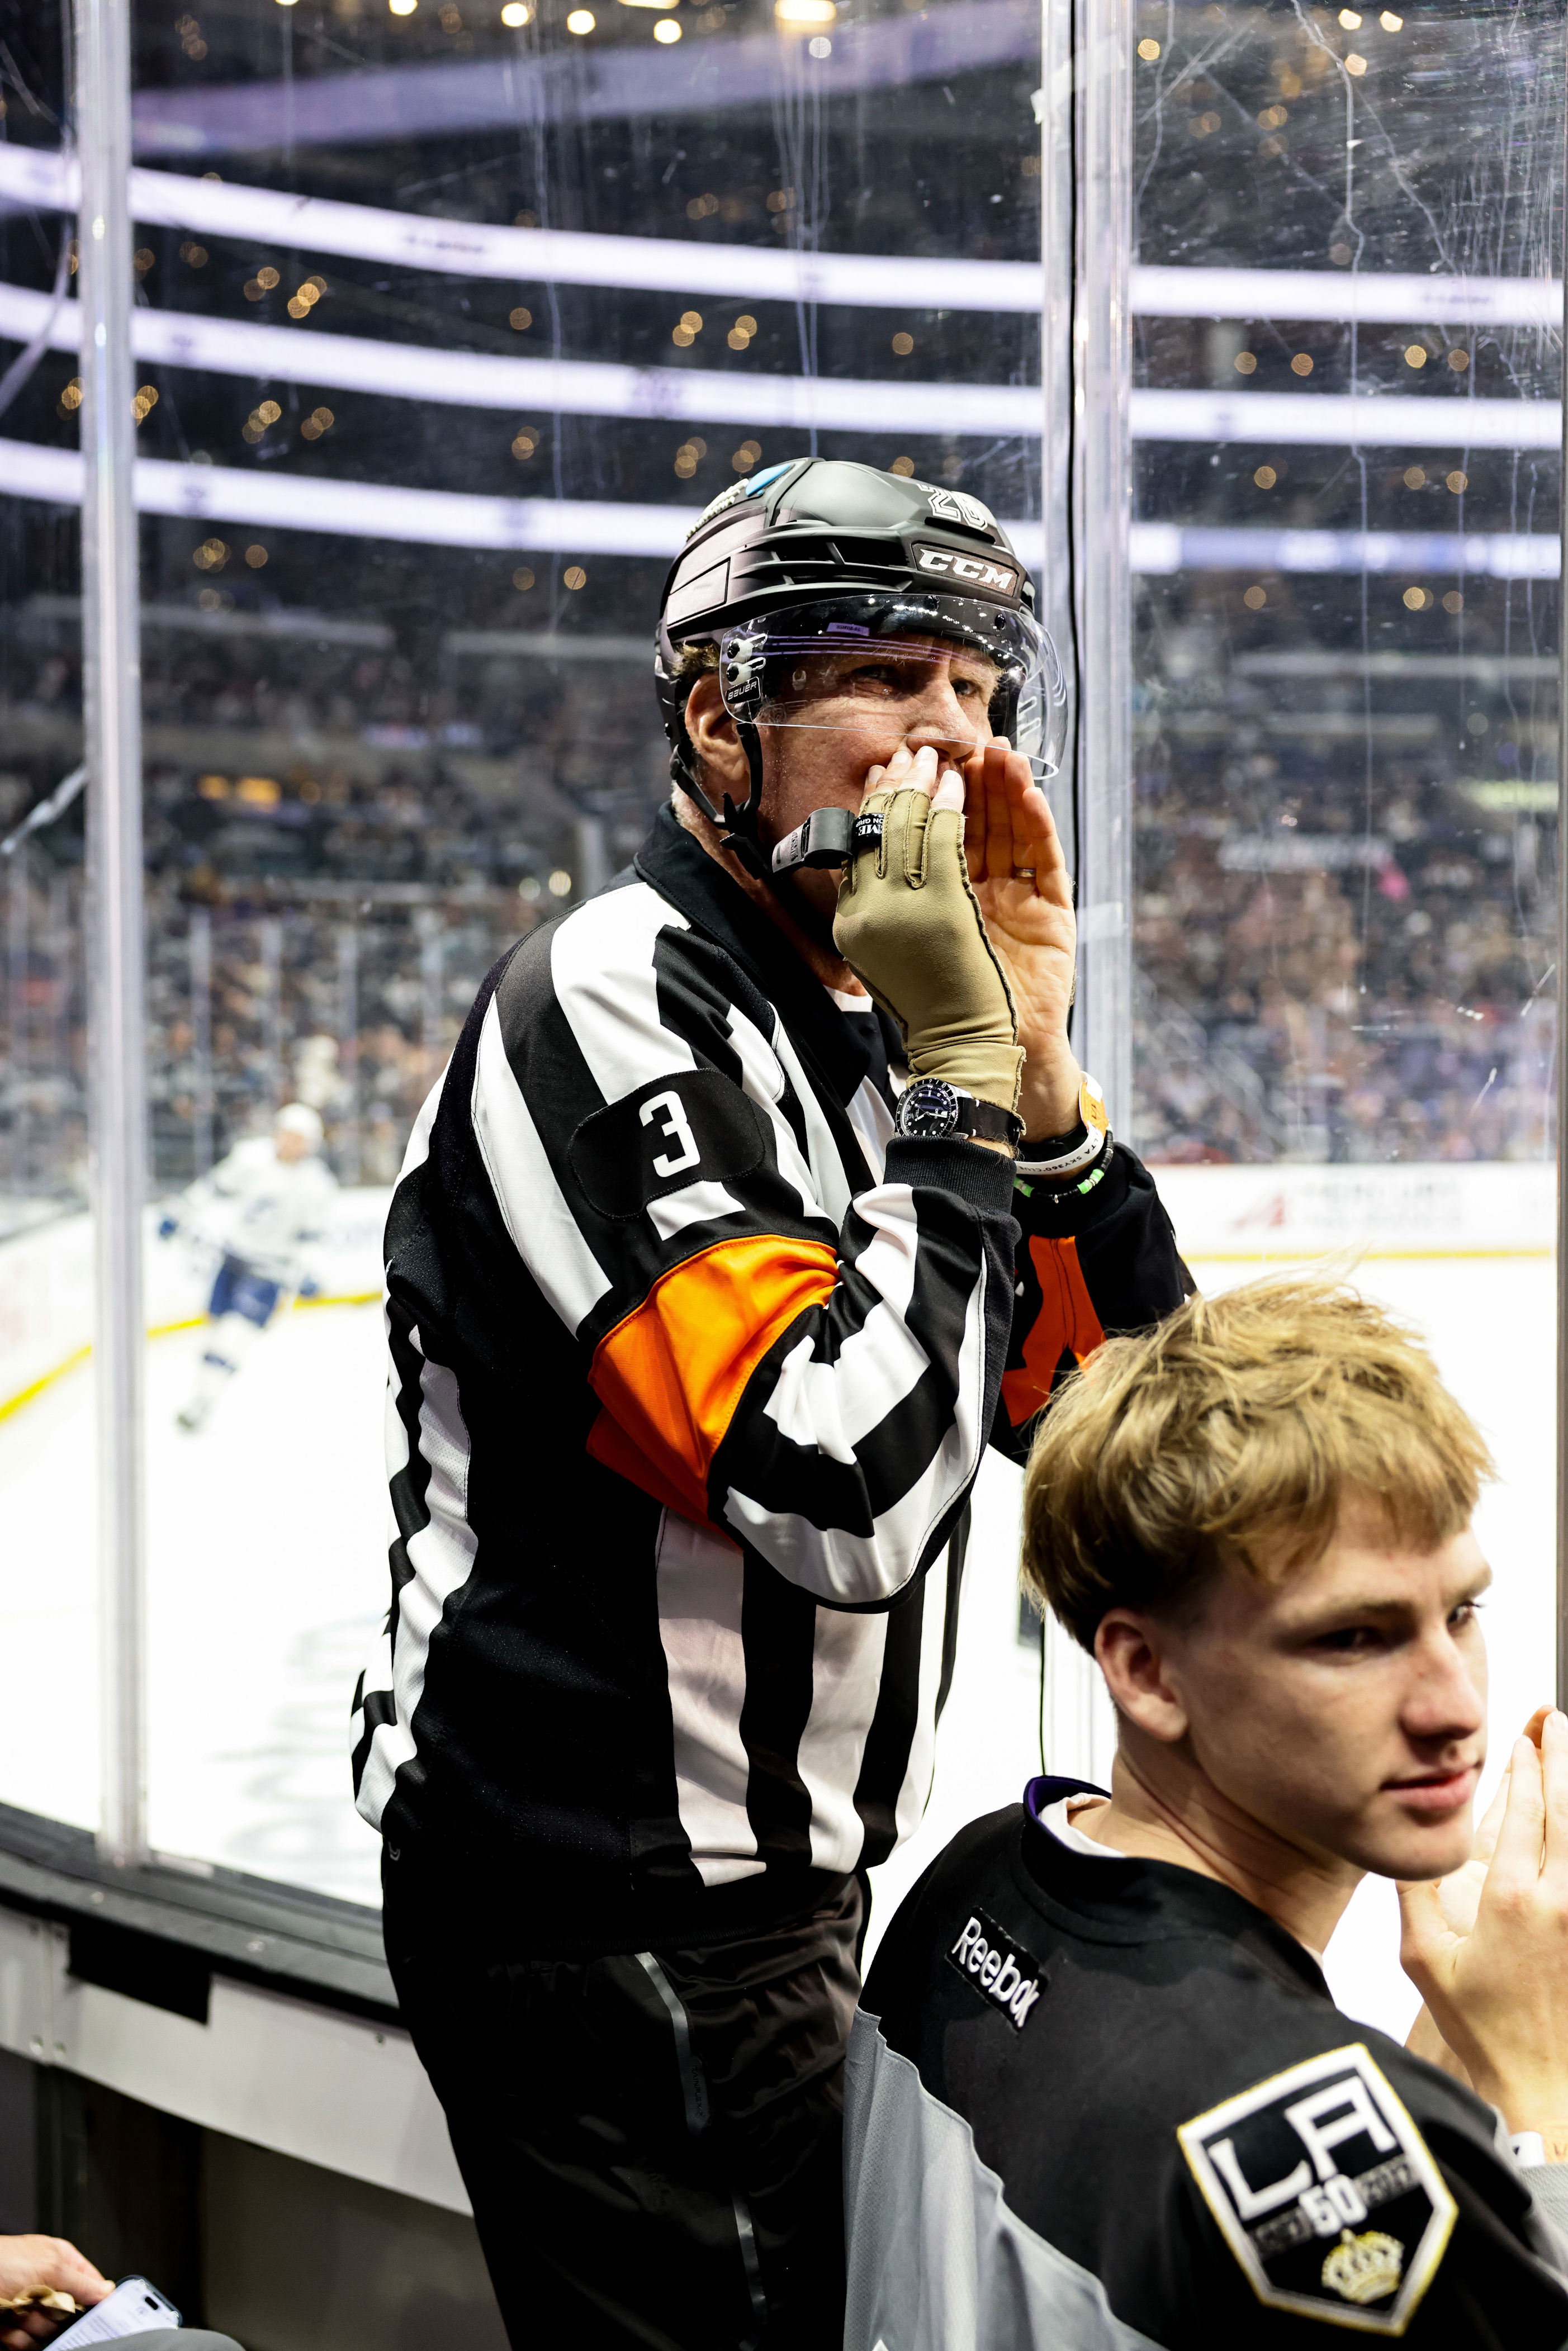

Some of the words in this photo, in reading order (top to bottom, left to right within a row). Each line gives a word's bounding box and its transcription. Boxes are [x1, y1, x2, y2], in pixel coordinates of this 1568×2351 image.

[919, 549, 1013, 590] CCM
[727, 680, 757, 700] BAUER
[856, 818, 871, 828] GRIP
[858, 824, 883, 836] ME
[638, 1090, 701, 1178] 3
[951, 1916, 1040, 2028] Reebok
[1207, 2075, 1398, 2221] LA
[1298, 2174, 1367, 2238] 50
